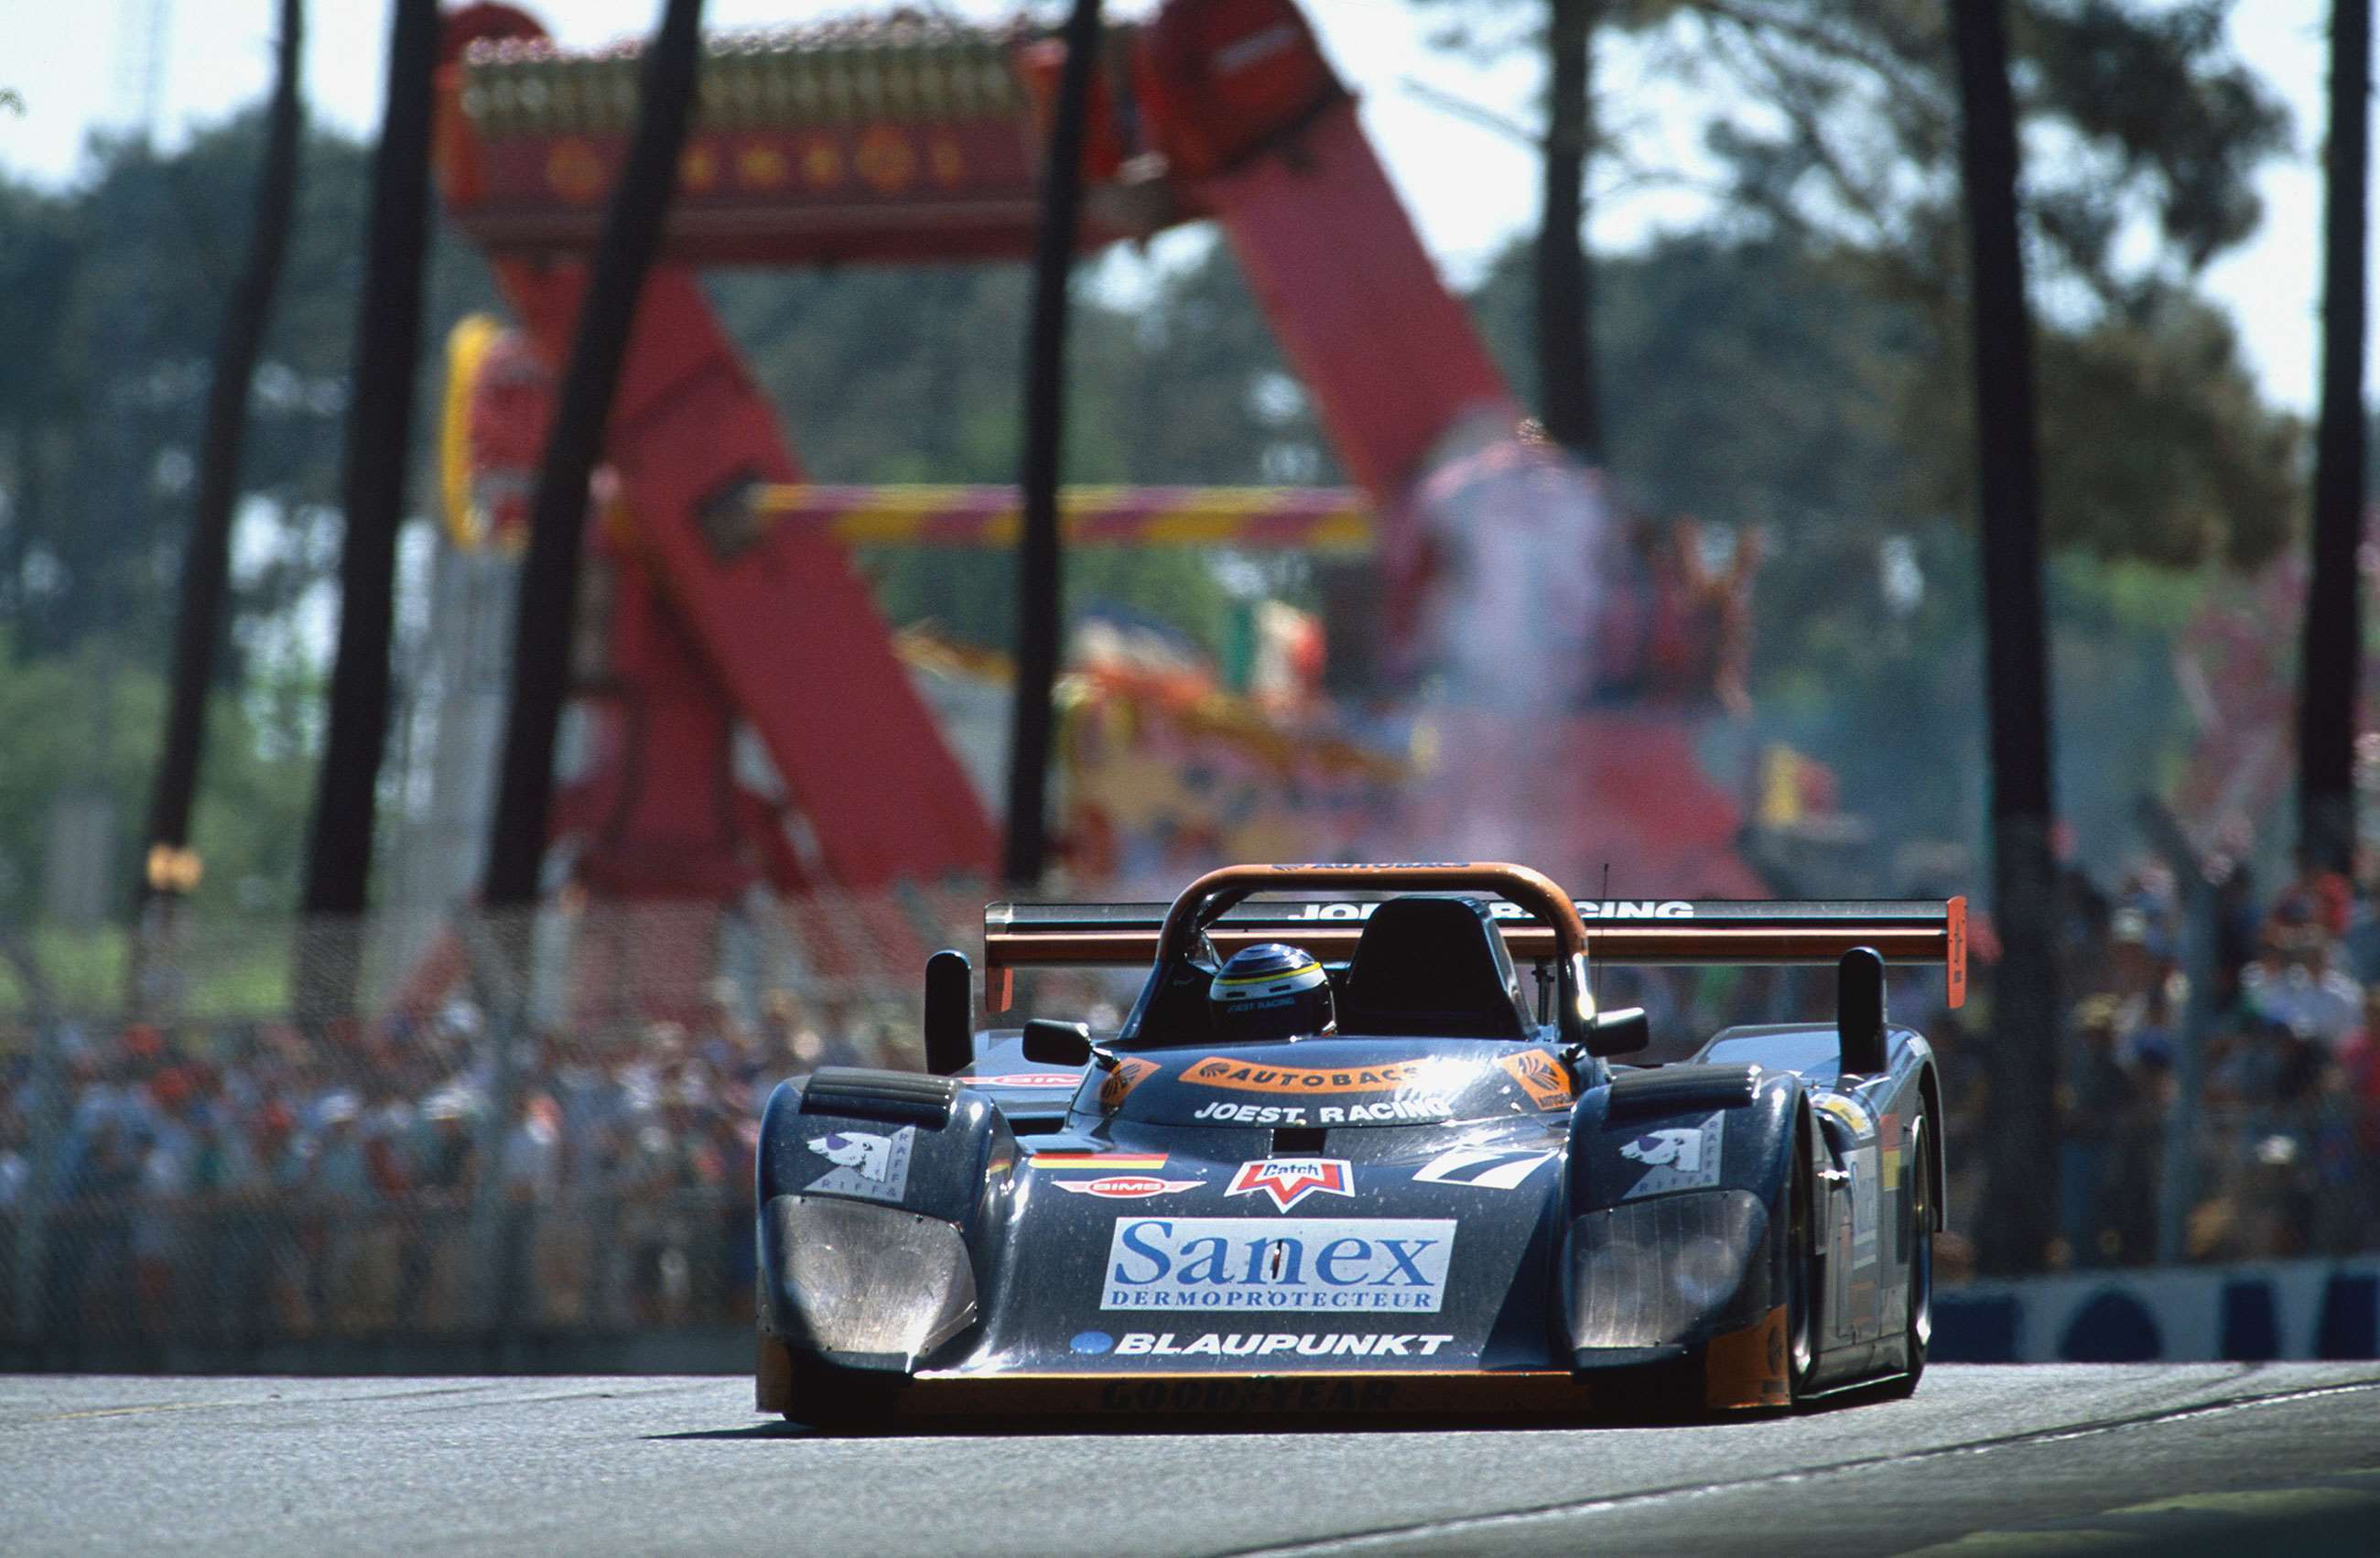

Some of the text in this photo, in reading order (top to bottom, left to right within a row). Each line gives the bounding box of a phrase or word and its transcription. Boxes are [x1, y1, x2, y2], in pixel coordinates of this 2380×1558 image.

[1489, 901, 1694, 919] RCING
[1194, 1098, 1454, 1124] JOEST RACING
[1263, 1163, 1319, 1176] Catch
[1114, 1220, 1438, 1286] Sanex
[1110, 1290, 1433, 1309] DERMOPROTECTEUR
[1114, 1333, 1454, 1356] BLAUPUNKT
